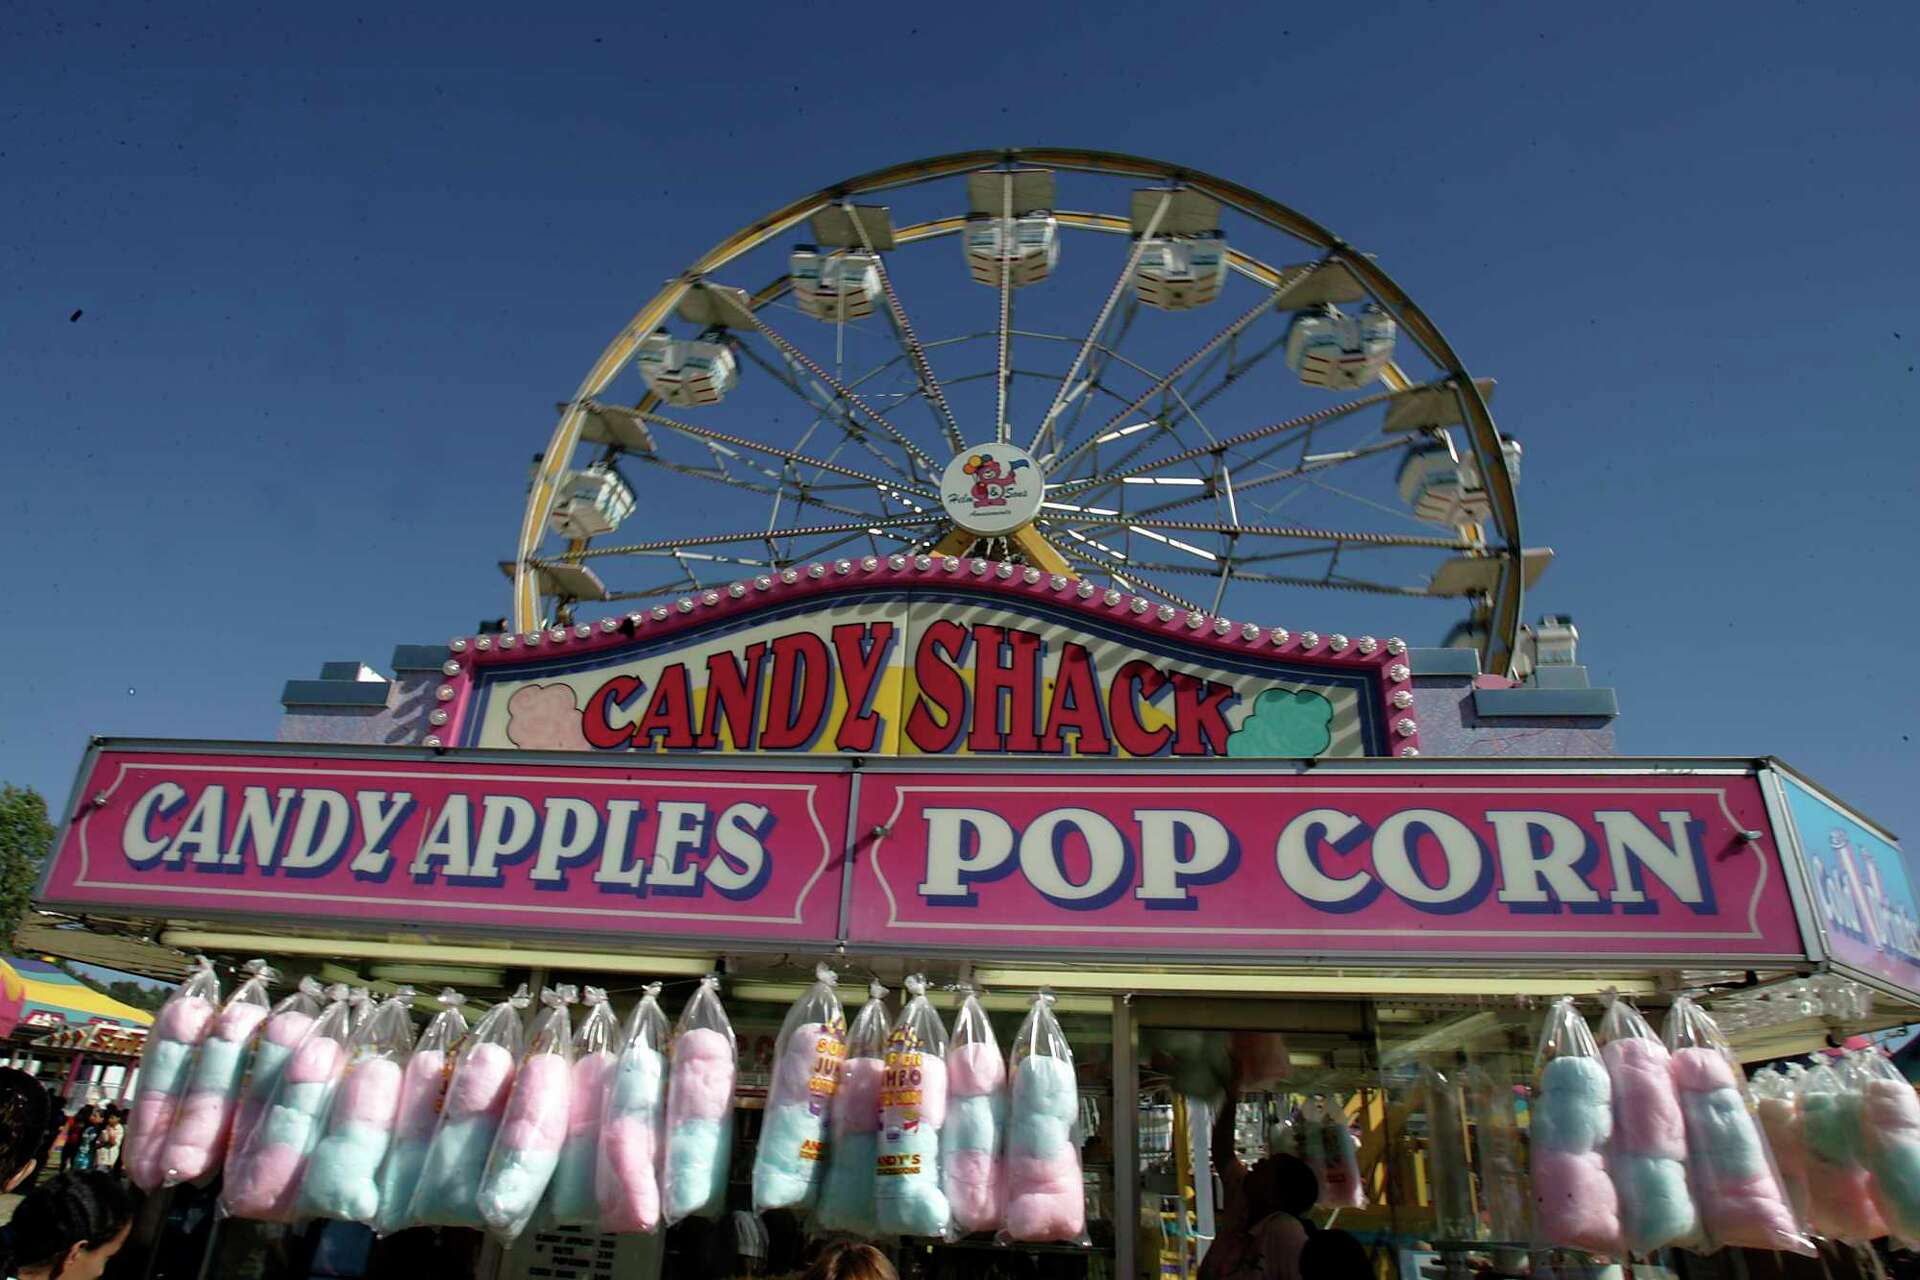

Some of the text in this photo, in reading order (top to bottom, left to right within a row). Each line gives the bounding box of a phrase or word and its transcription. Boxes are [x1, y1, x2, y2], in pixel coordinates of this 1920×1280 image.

[582, 619, 1235, 756] CANDY SHACK
[121, 781, 775, 897] CANDY APPLES
[917, 807, 1716, 914] POP CORN
